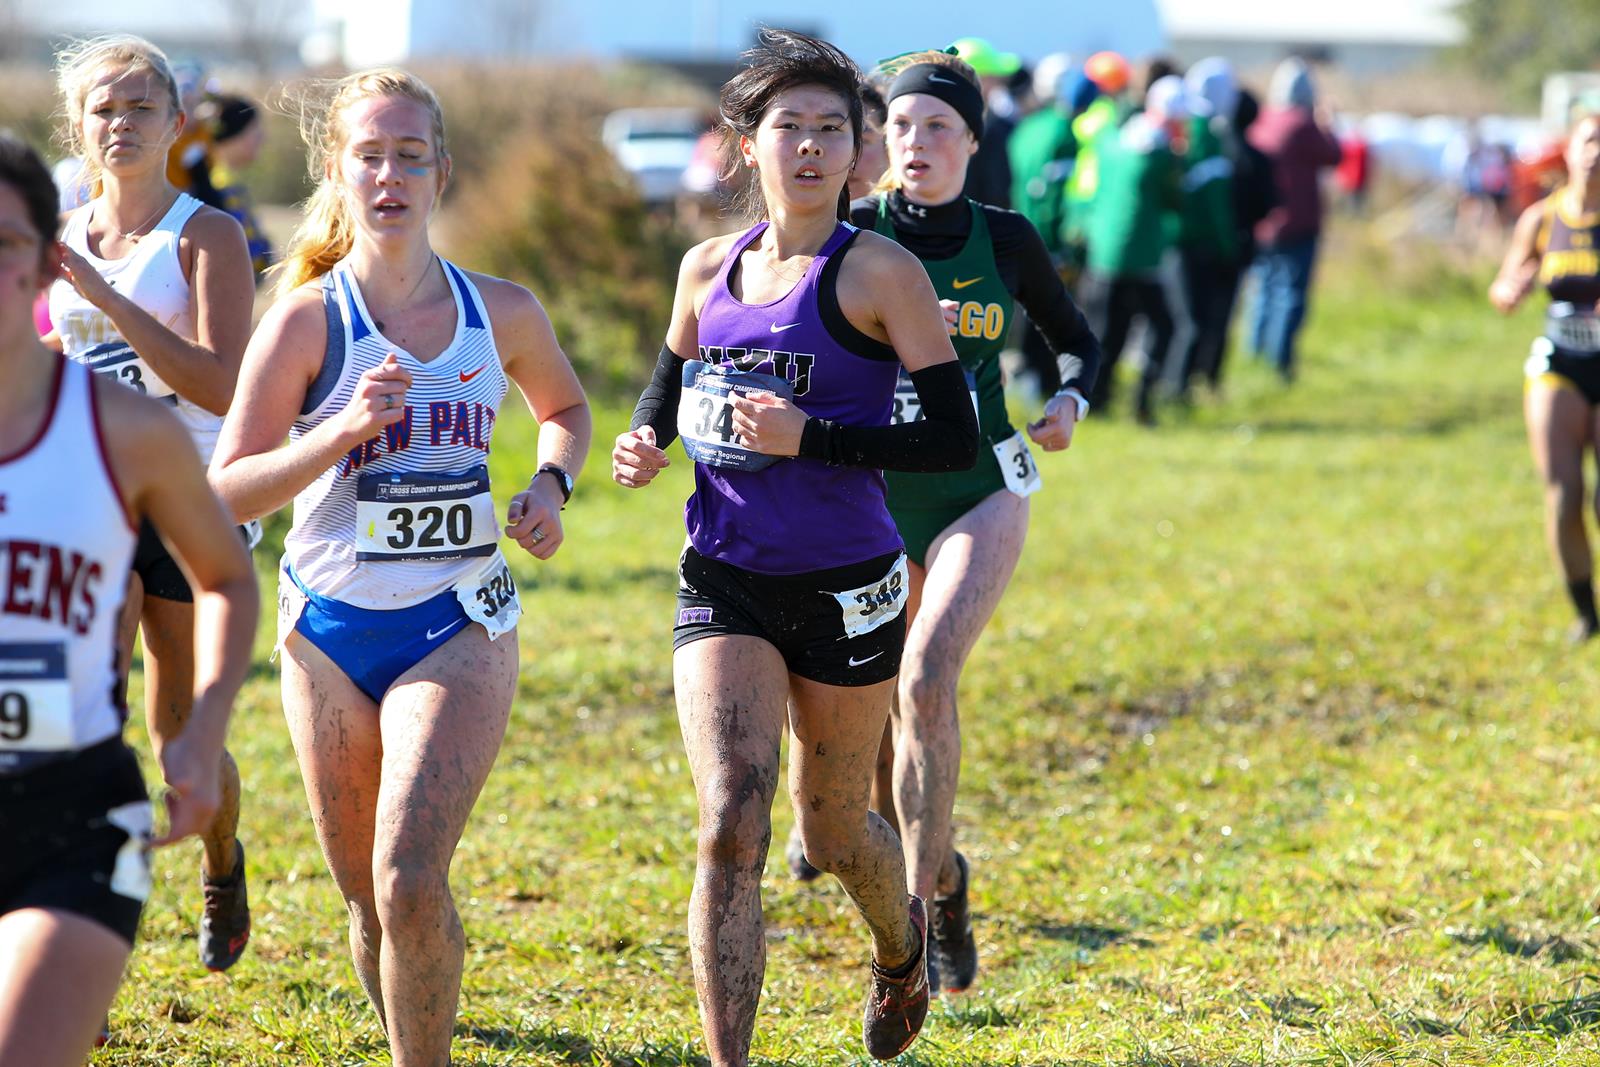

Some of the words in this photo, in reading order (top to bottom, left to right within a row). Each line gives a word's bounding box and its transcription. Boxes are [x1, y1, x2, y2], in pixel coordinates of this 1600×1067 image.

[947, 300, 1004, 341] GO
[694, 397, 741, 444] 34
[718, 449, 747, 462] Regional
[389, 486, 410, 495] CROSS
[410, 485, 437, 495] COUNTRY
[437, 480, 480, 493] CHAMPIONSHIPS
[386, 503, 473, 550] 320
[475, 565, 517, 619] 320
[853, 570, 903, 617] 342
[679, 607, 713, 626] NYU
